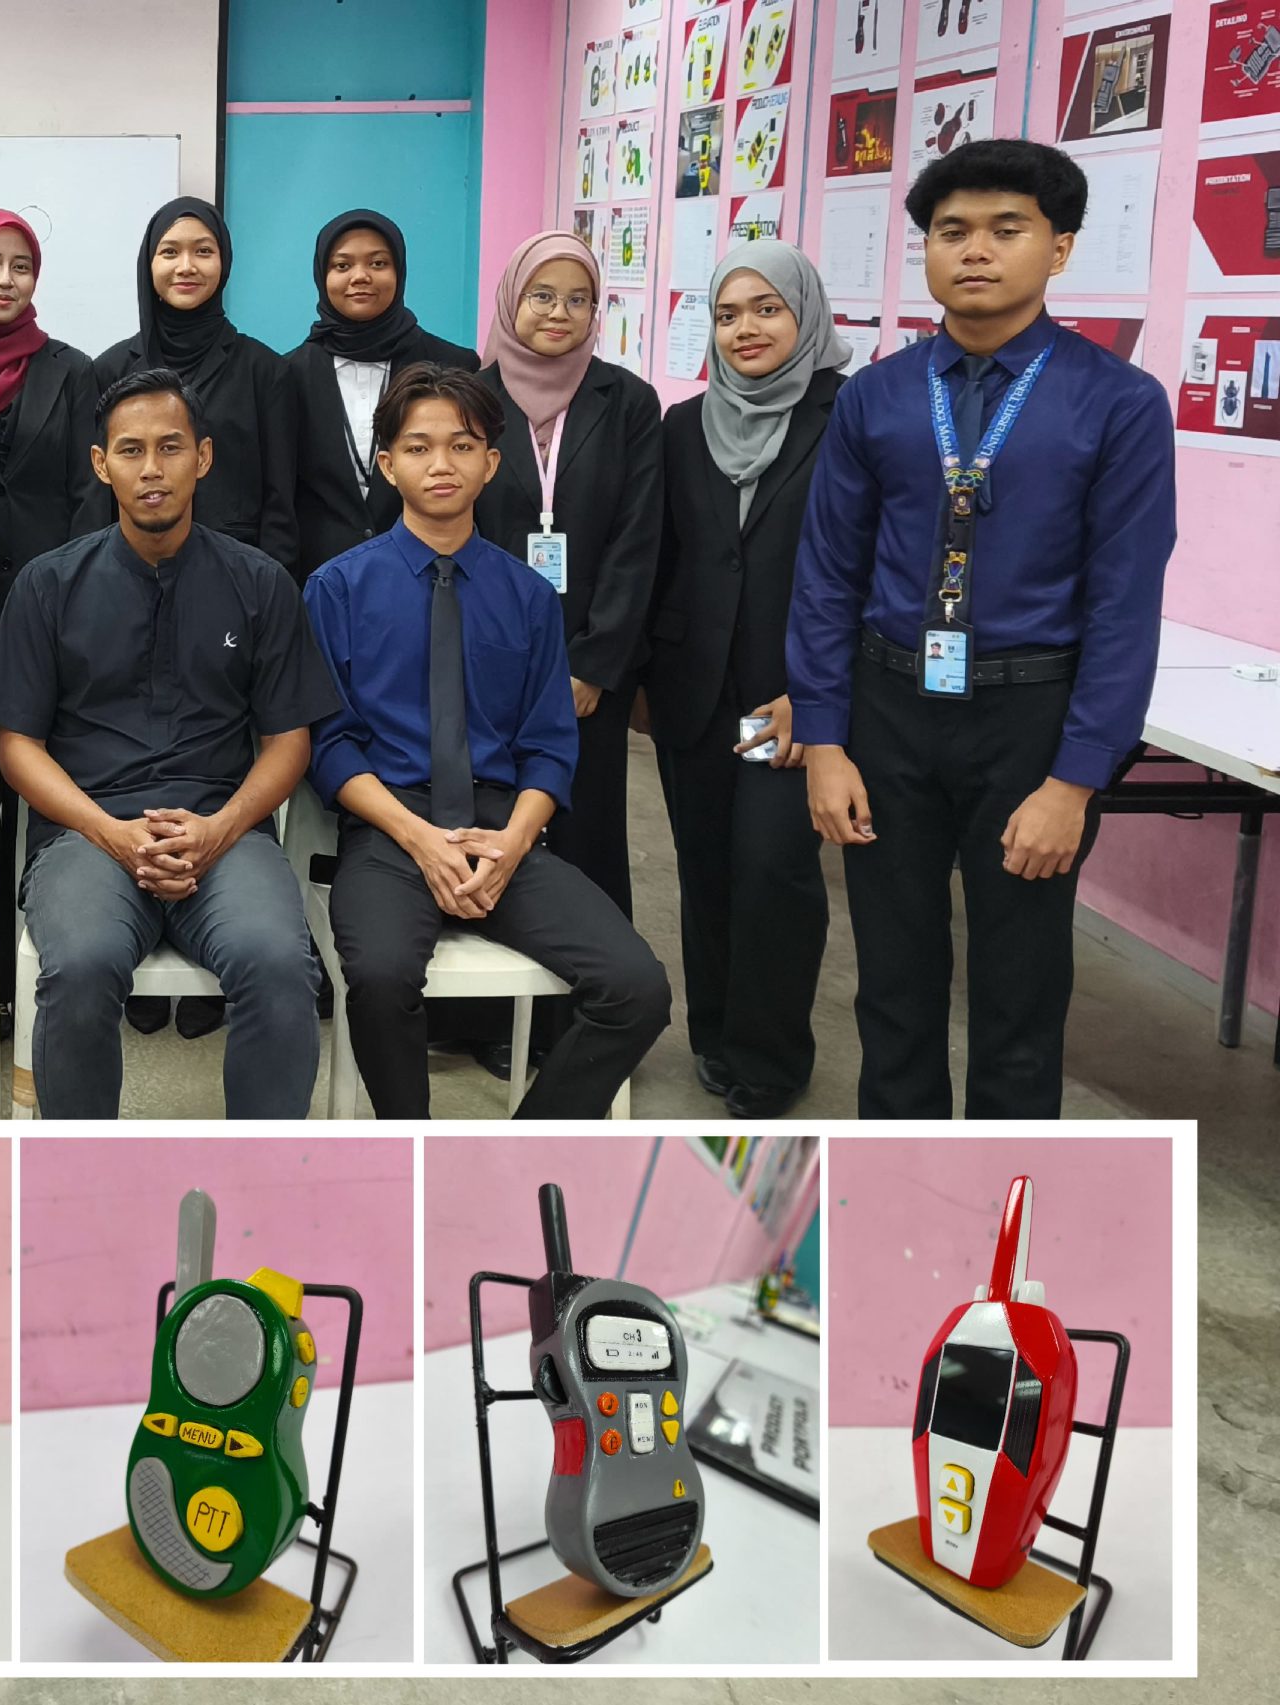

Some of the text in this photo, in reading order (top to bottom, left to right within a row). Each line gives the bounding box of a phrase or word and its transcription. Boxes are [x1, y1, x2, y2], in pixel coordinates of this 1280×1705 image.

[931, 368, 953, 455] EKNOLOGI MARA
[980, 403, 1017, 457] UNIVERSITI
[623, 1328, 642, 1342] CH 3
[181, 1427, 217, 1445] MENU
[194, 1501, 230, 1538] PTT
